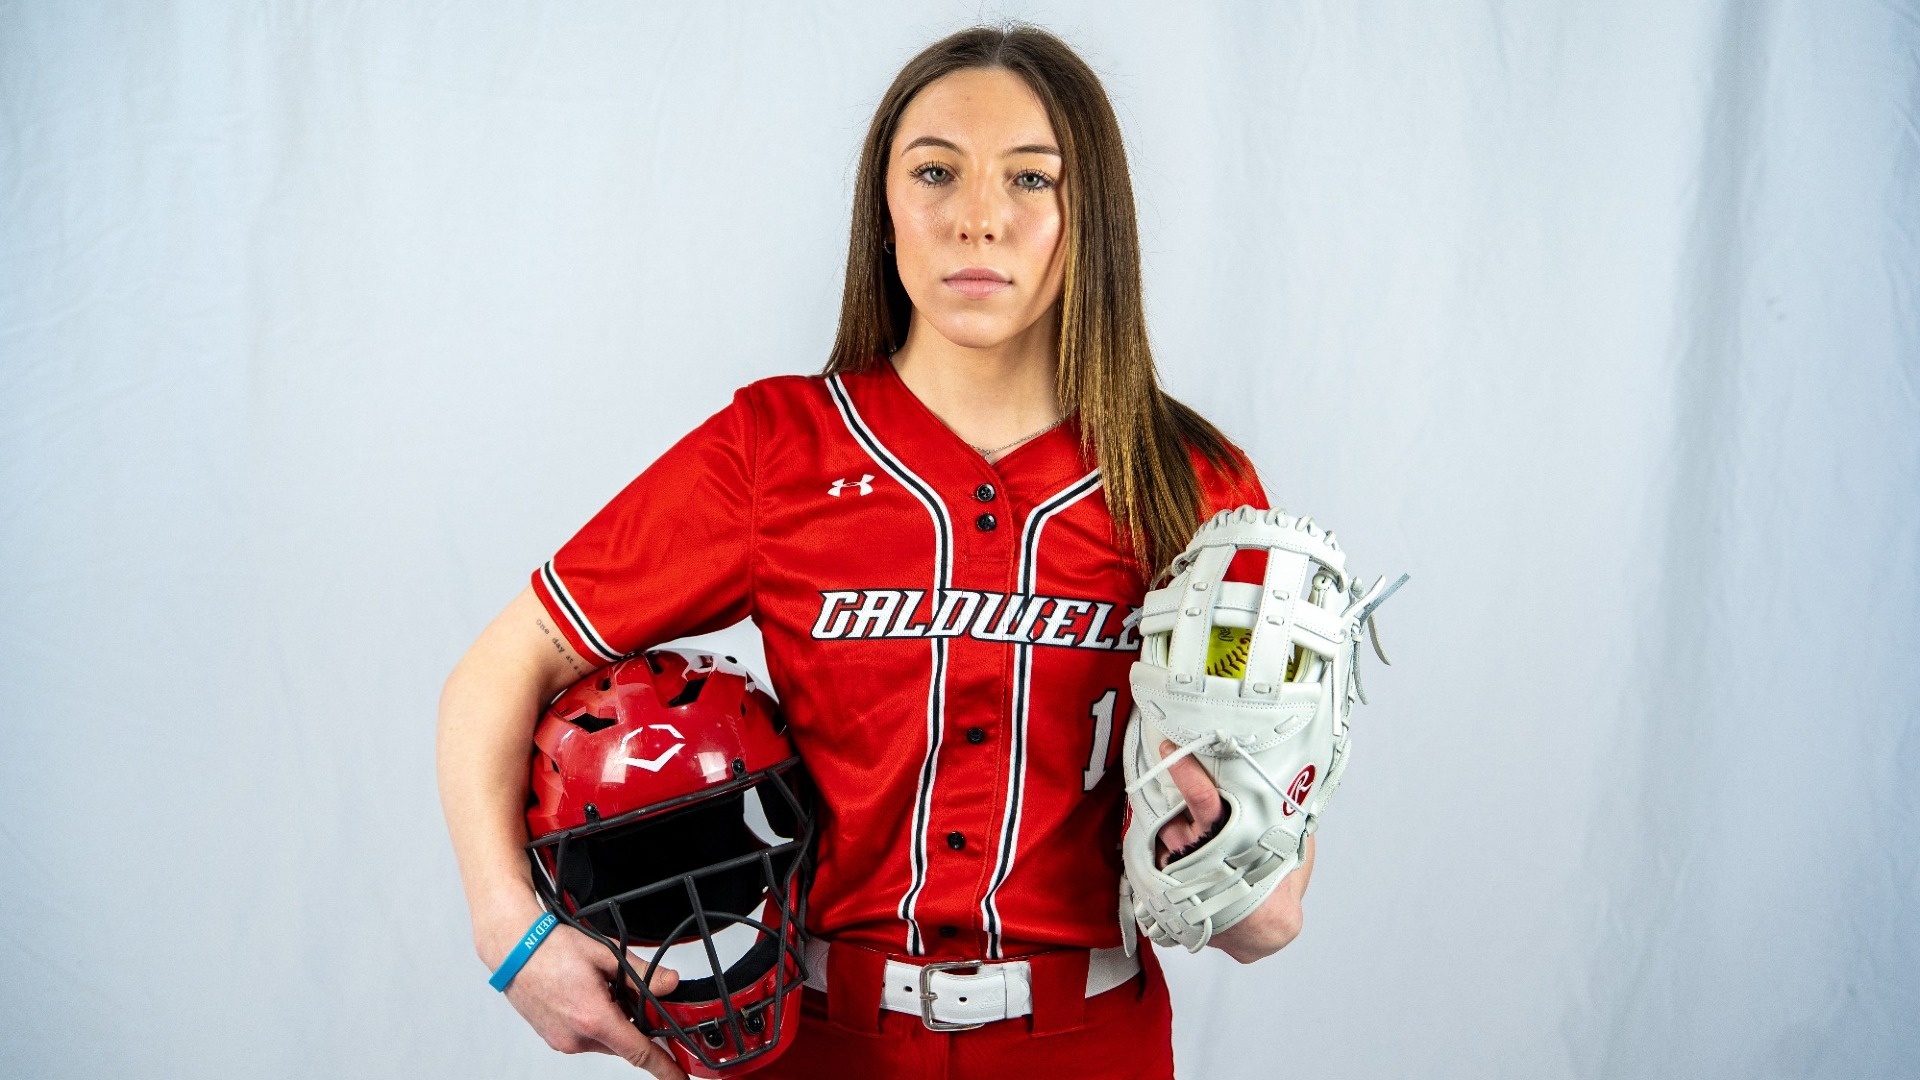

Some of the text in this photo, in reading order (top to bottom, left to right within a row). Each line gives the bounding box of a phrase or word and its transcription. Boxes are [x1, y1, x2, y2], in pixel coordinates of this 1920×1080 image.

[535, 619, 550, 634] One
[552, 637, 565, 653] day
[811, 588, 1142, 652] CALDWELL
[524, 933, 539, 950] IN
